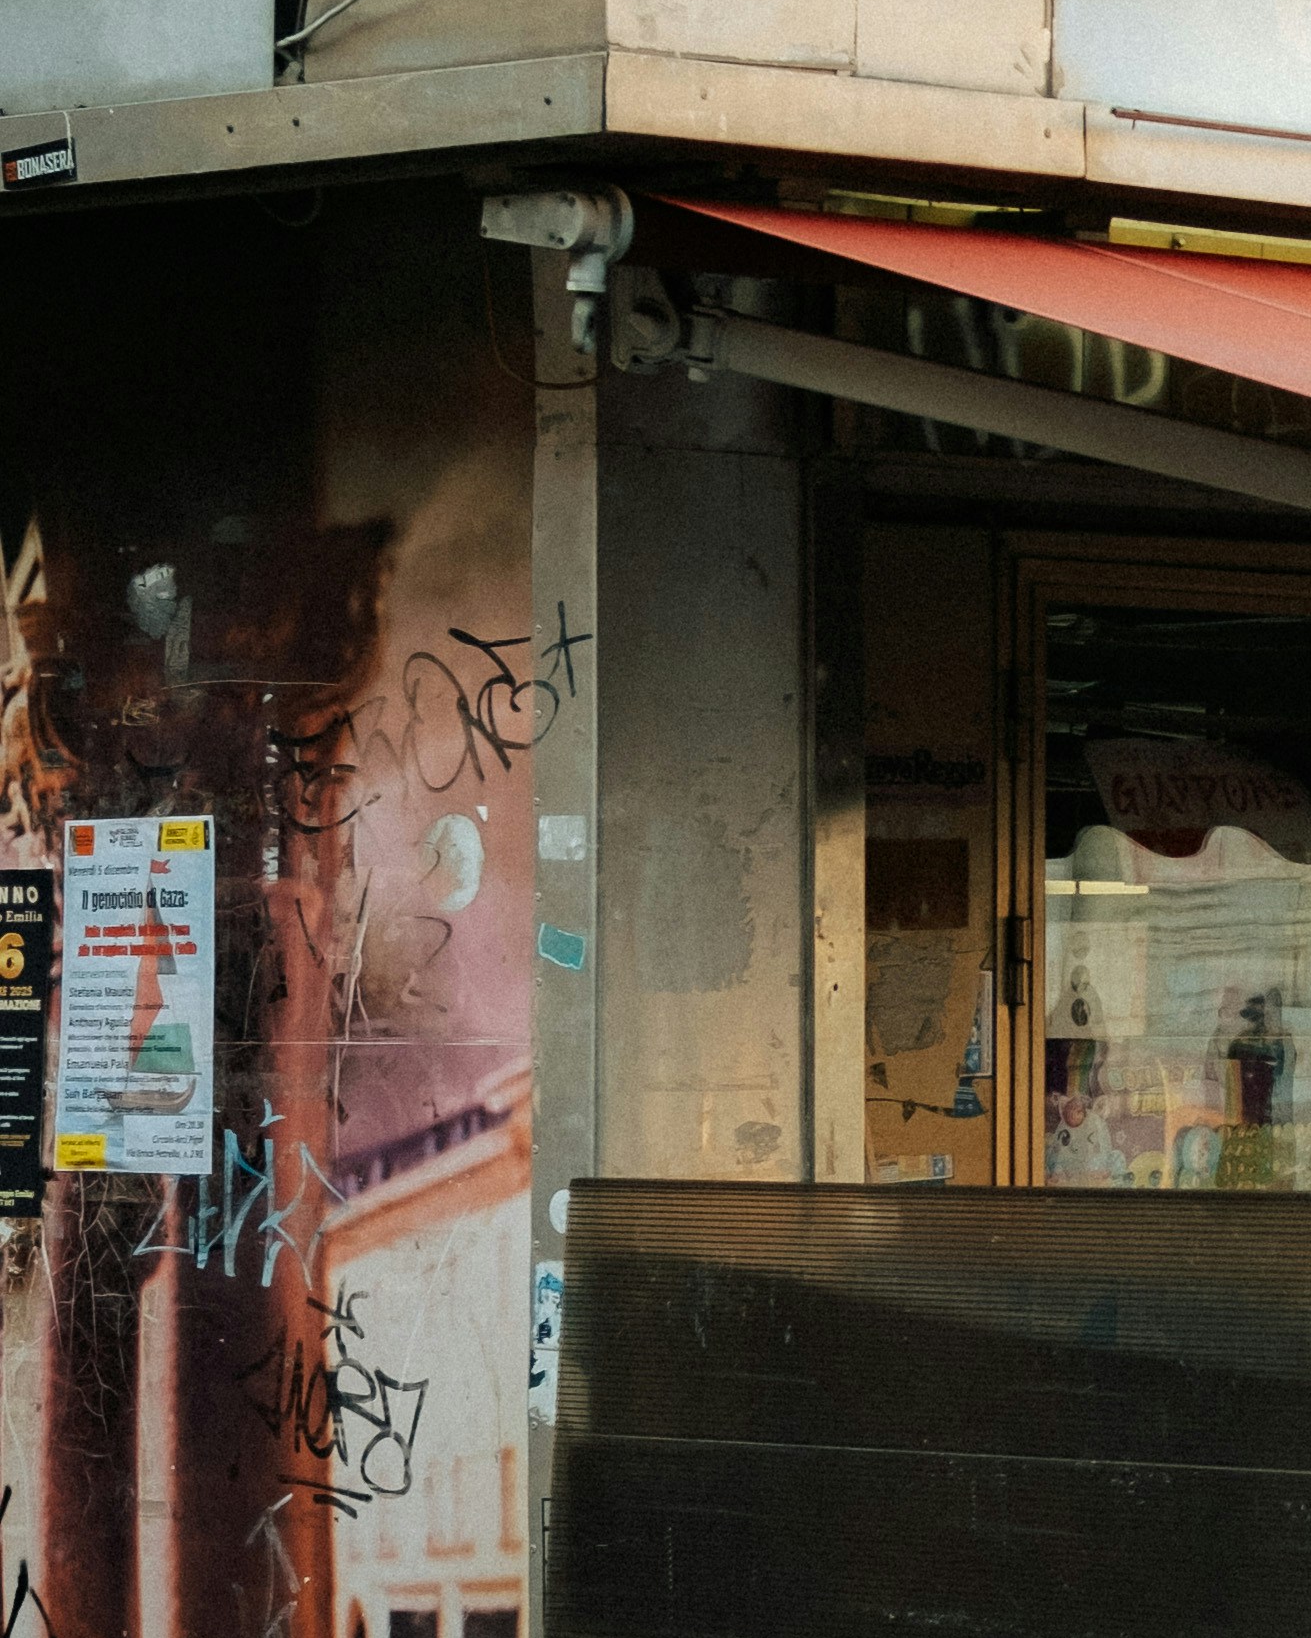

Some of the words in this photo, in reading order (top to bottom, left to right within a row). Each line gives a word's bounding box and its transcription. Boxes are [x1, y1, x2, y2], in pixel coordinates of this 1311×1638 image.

[16, 148, 75, 180] BONASERA
[92, 888, 143, 912] genocidio
[146, 887, 156, 909] di
[160, 888, 189, 909] Gaza:
[6, 911, 43, 922] Emilia
